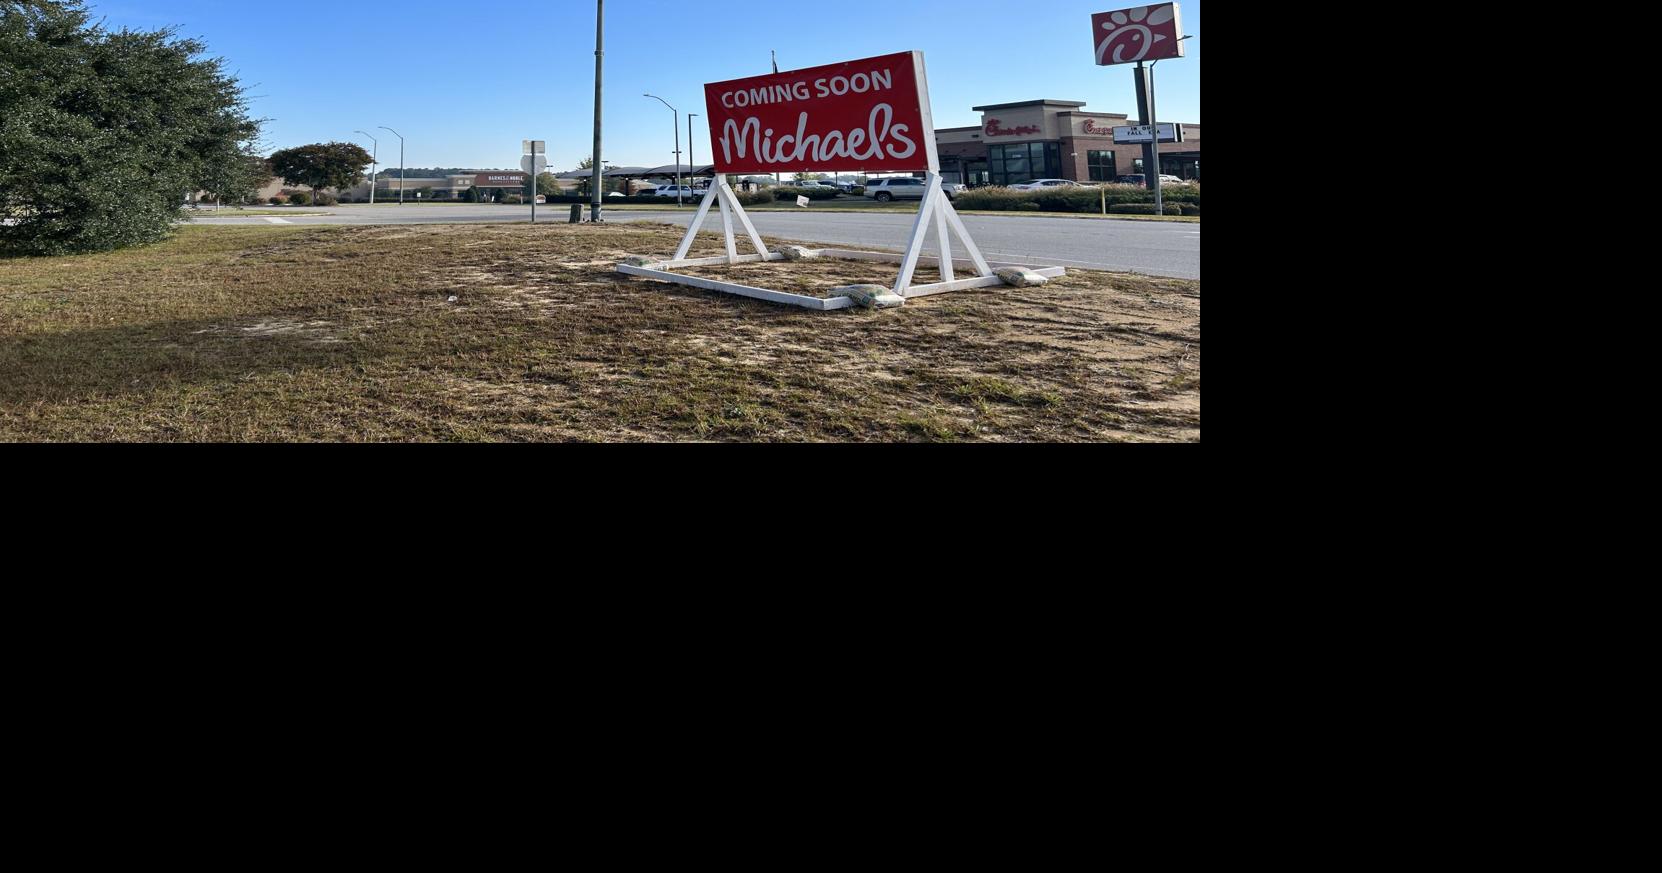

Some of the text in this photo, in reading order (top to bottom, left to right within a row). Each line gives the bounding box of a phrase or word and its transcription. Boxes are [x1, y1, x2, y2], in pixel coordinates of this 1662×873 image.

[721, 68, 892, 108] COMING SOON
[719, 102, 917, 164] Michaels
